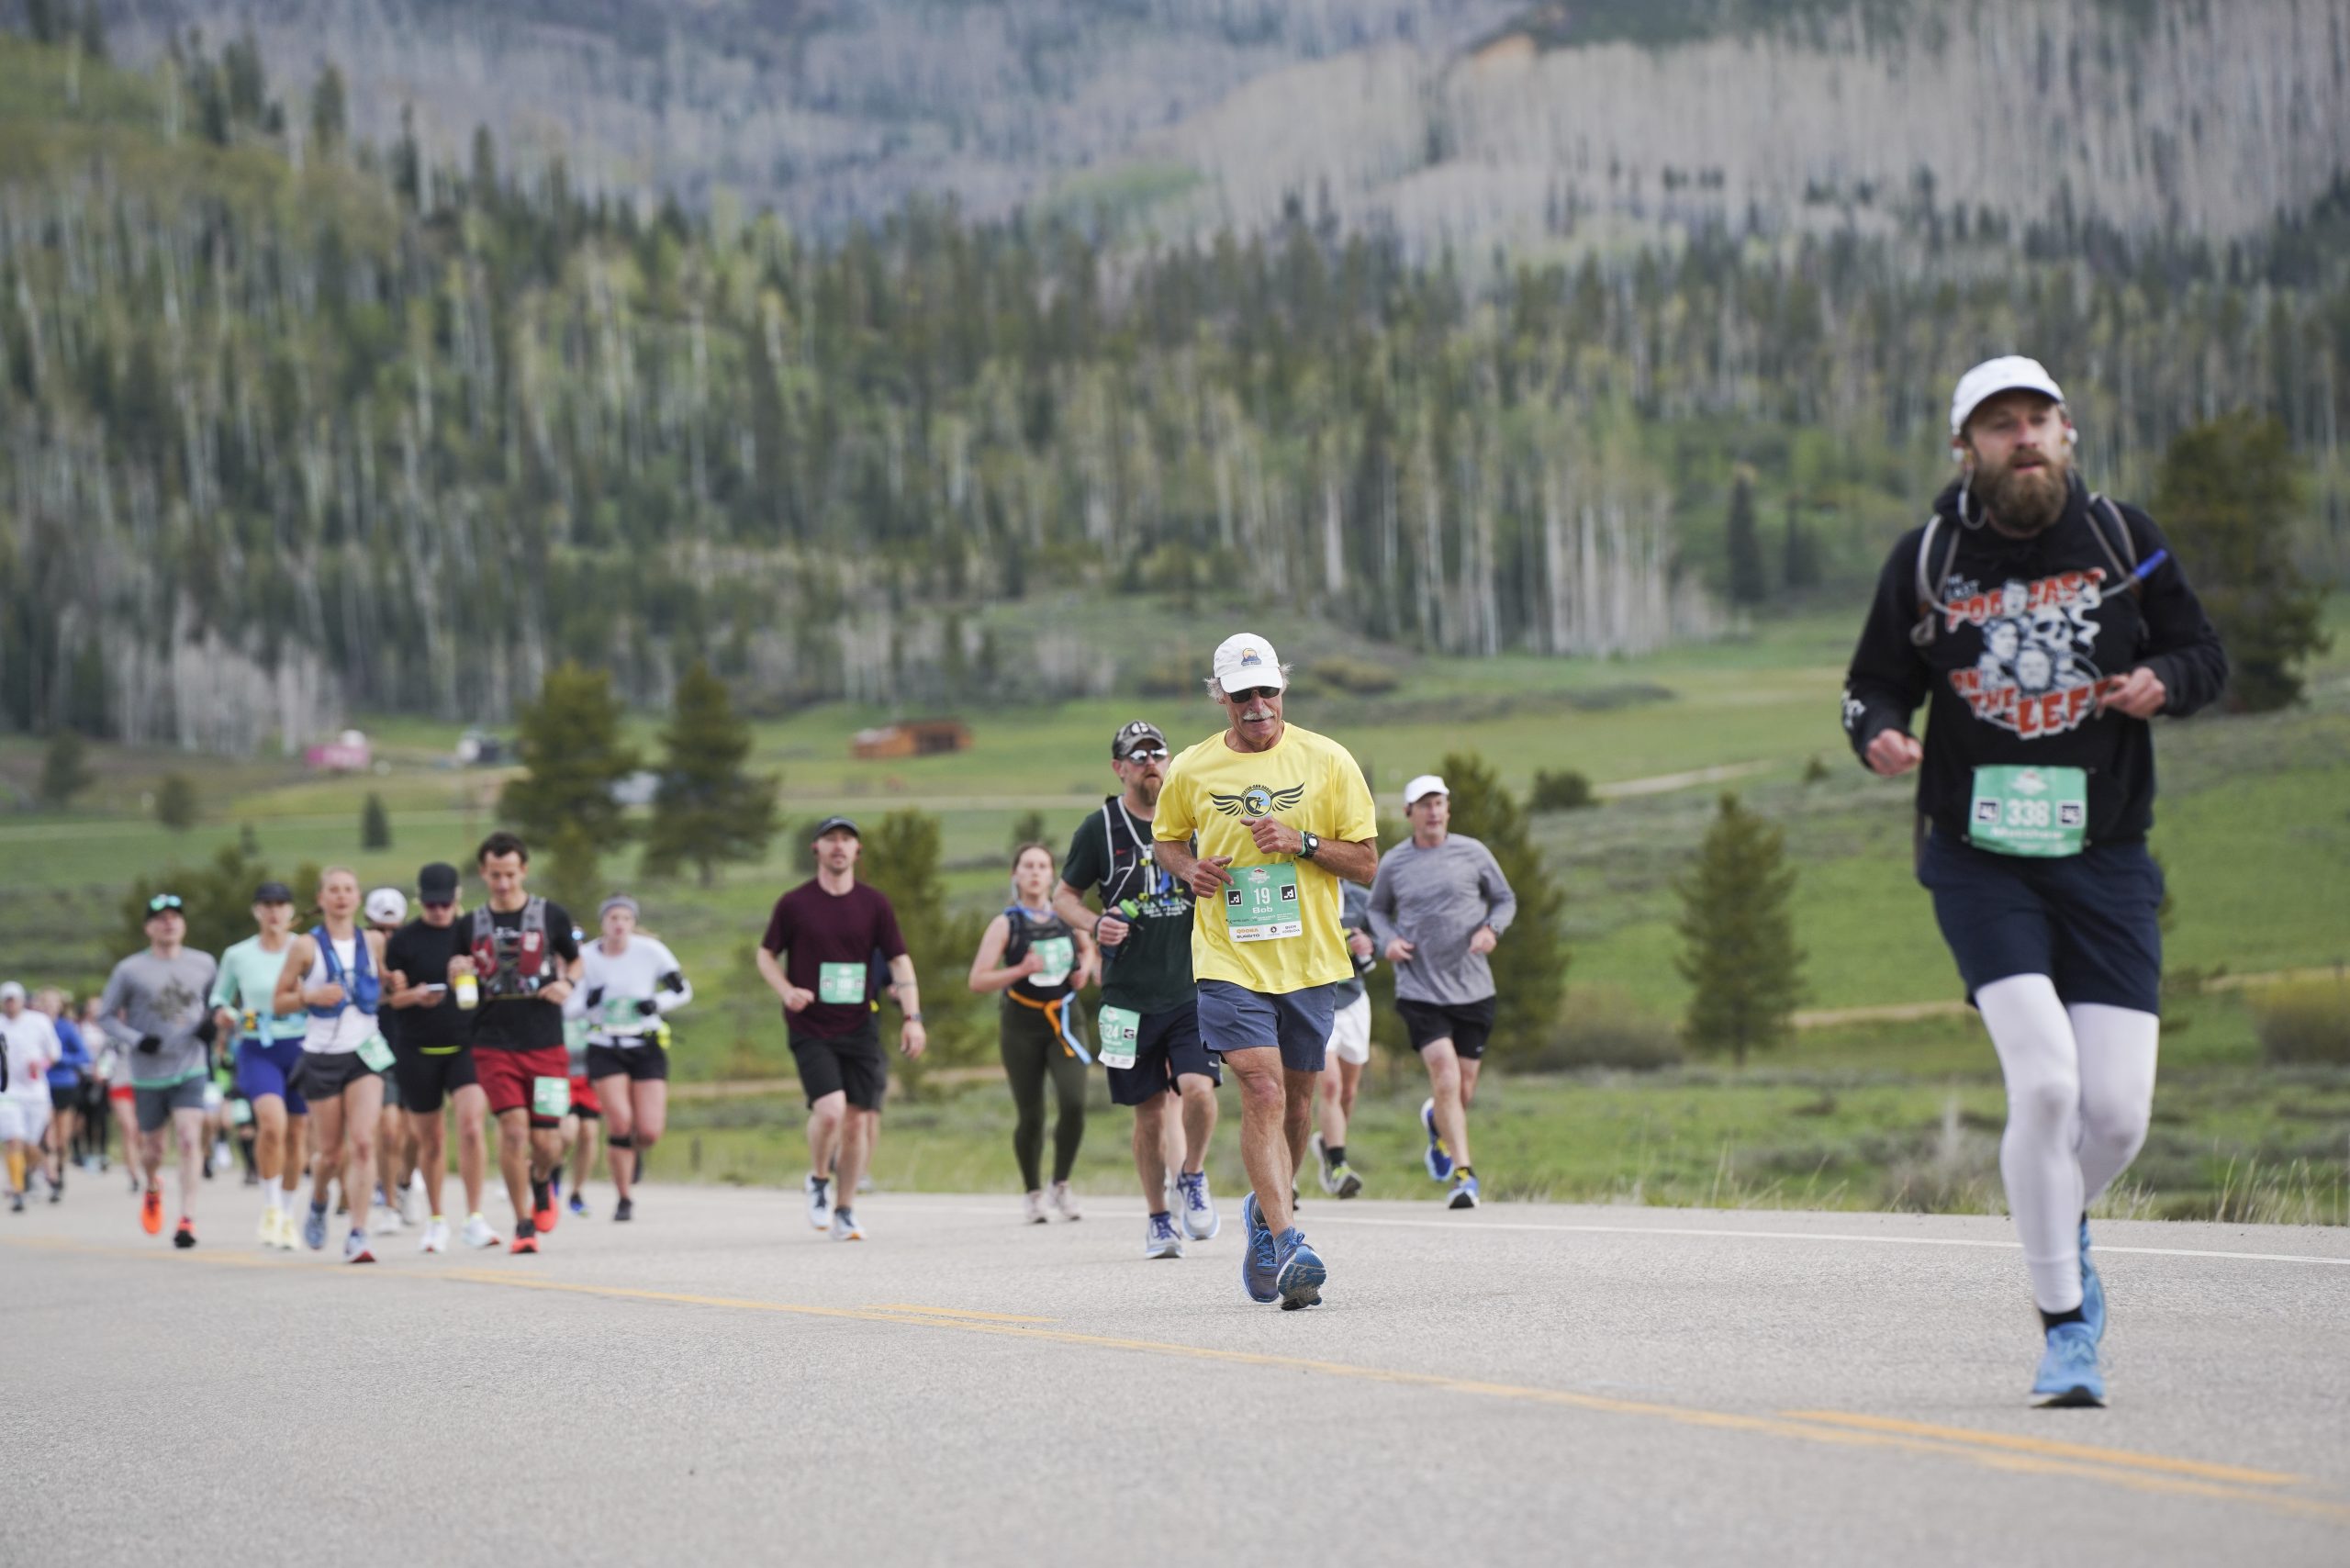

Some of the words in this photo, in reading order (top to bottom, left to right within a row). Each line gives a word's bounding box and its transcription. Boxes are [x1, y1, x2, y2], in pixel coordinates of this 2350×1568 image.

[1968, 685, 2017, 719] THE
[2007, 798, 2050, 827] 338
[1253, 887, 1270, 904] 19
